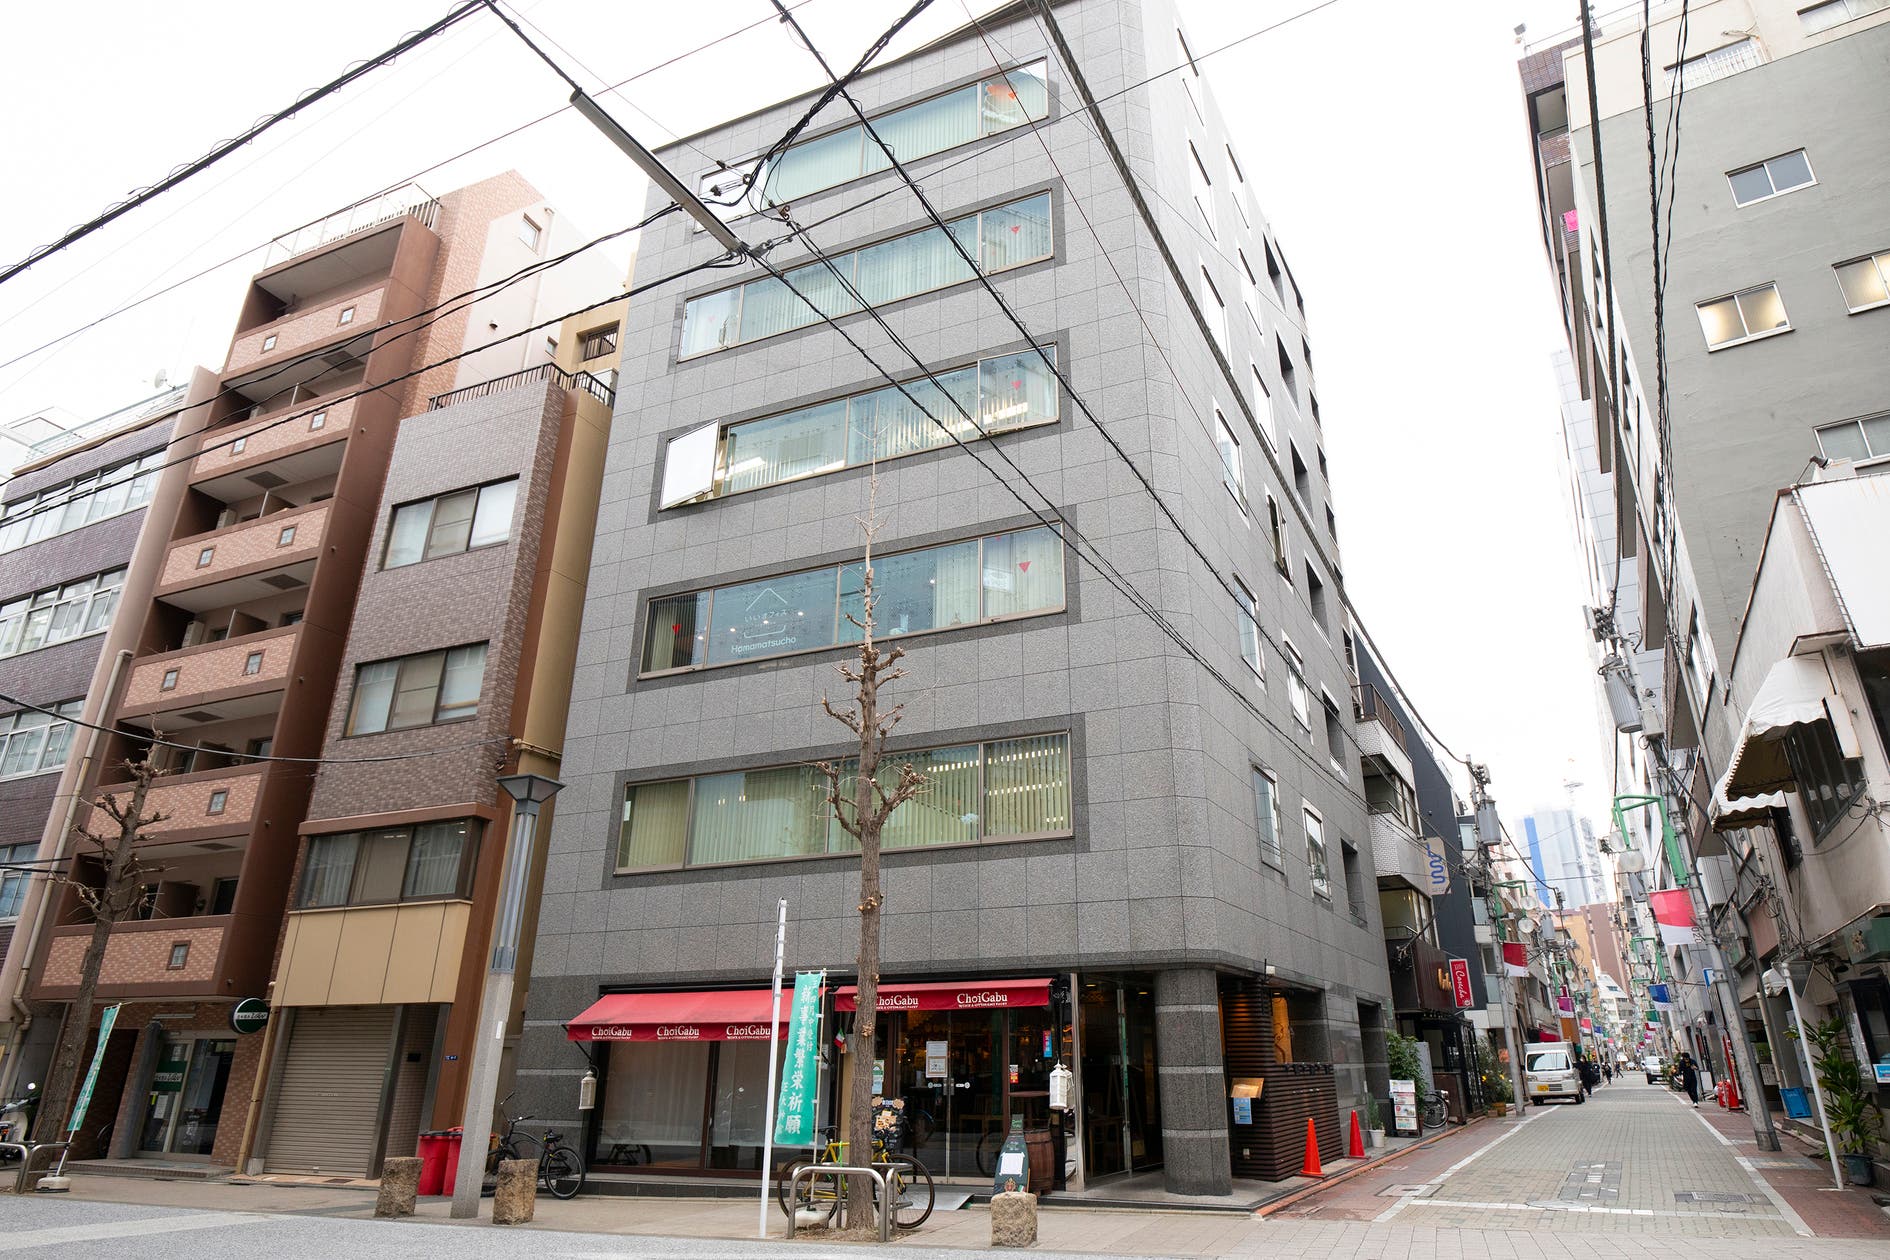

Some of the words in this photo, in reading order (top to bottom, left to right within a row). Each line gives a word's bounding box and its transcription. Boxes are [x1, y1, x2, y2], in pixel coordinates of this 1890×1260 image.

[731, 637, 797, 653] Hamamatsucho
[876, 994, 919, 1006] hoiGabu
[956, 992, 1008, 1004] ChoiGabu
[591, 1026, 632, 1037] ChoiGabu
[656, 1025, 700, 1036] ChoiGabu
[726, 1024, 771, 1036] ChoiGabu
